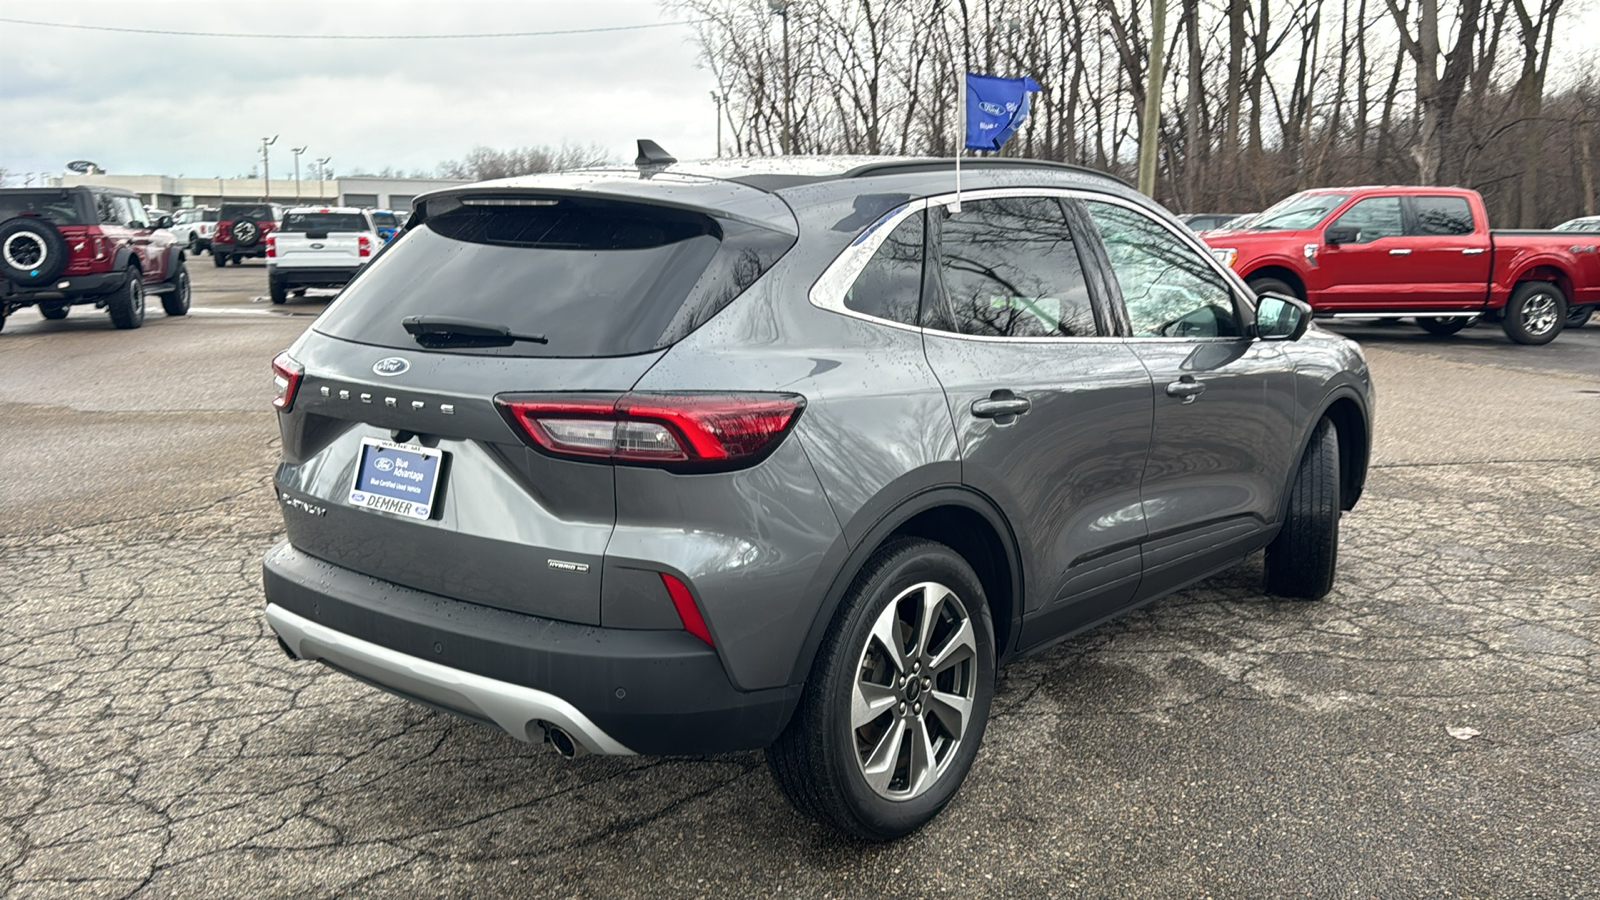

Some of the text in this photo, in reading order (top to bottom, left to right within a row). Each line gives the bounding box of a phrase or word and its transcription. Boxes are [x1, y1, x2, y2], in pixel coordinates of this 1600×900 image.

[320, 386, 455, 415] ESCAPE
[395, 457, 409, 468] Blue
[393, 467, 424, 482] Advantage
[379, 480, 396, 489] Certified
[396, 482, 408, 491] Used
[407, 484, 421, 494] Vehicle
[367, 494, 412, 515] DEMMER
[549, 561, 576, 571] HYBRID
